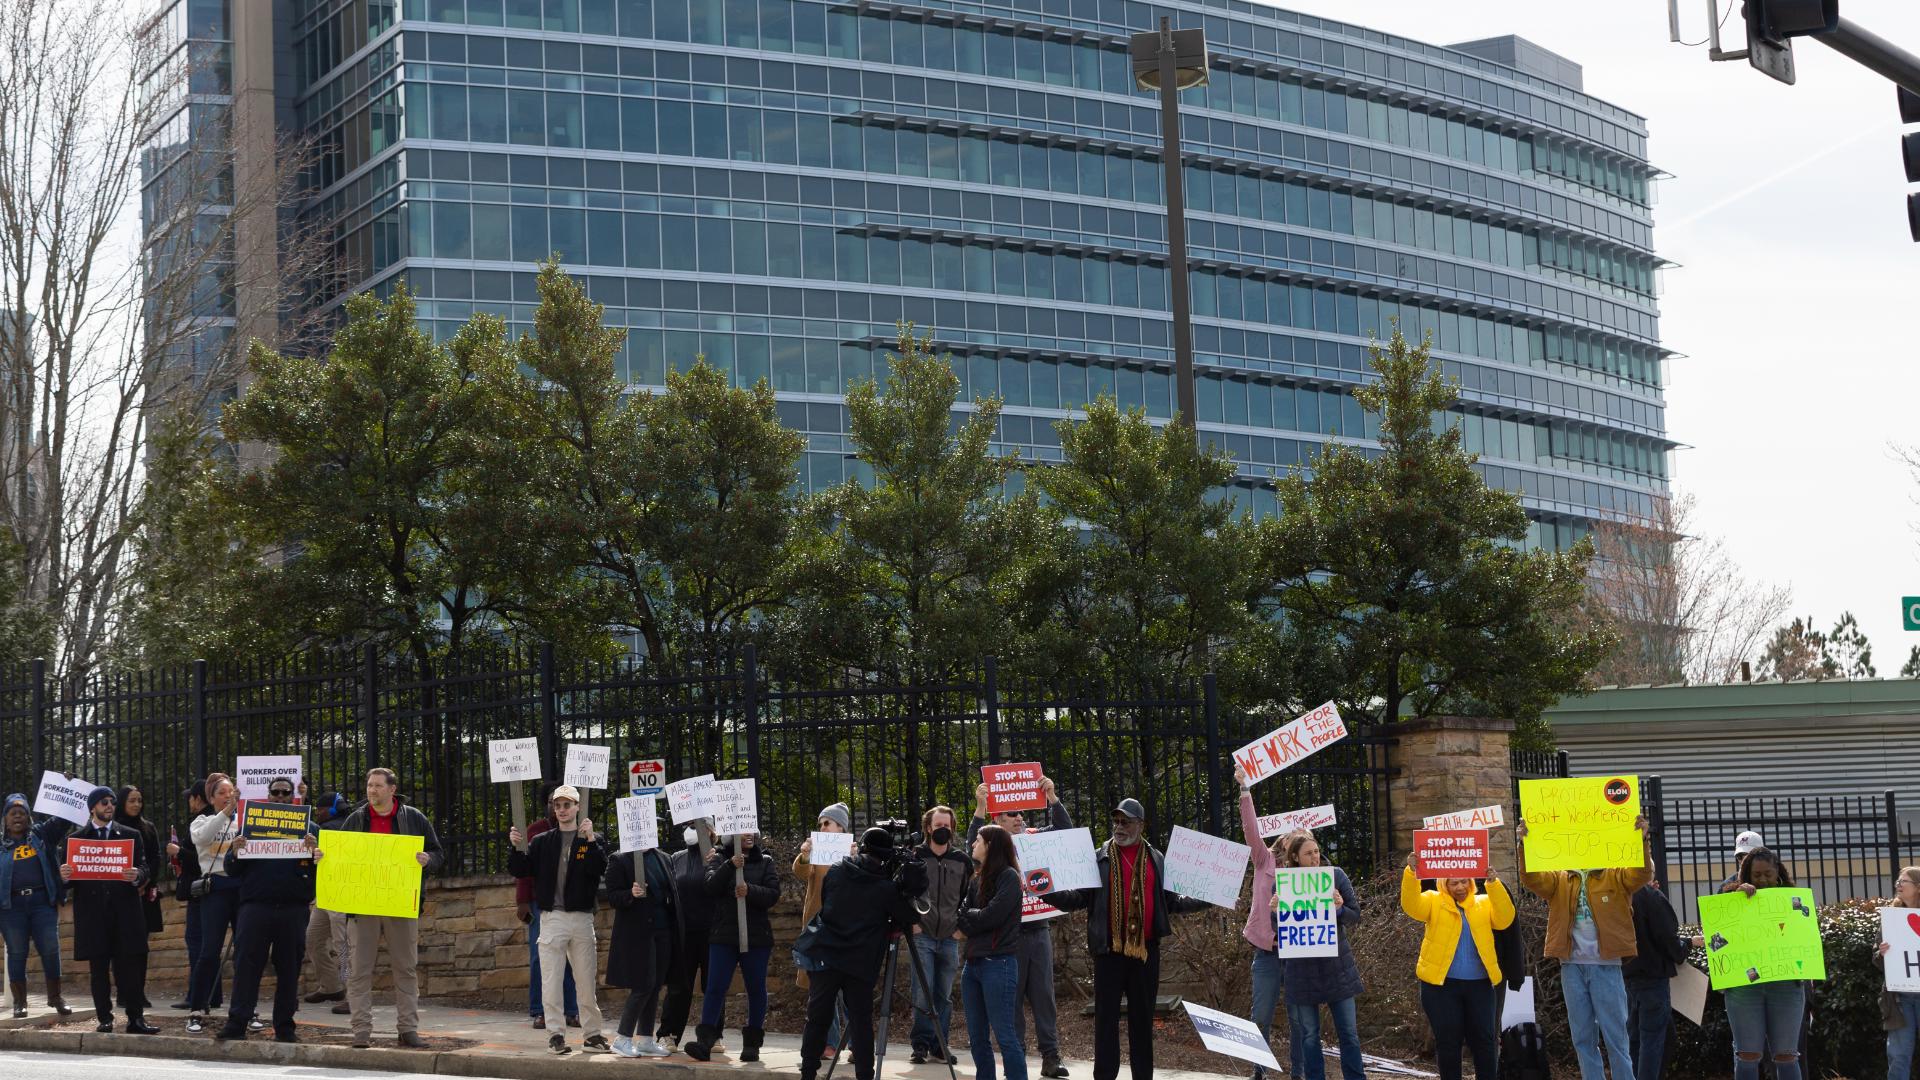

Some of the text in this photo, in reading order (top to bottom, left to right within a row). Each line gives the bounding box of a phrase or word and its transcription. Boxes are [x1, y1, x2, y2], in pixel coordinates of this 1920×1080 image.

[1307, 717, 1335, 735] THE
[1236, 705, 1334, 780] WE WORK FOR
[1310, 724, 1345, 749] PEOPLE
[512, 754, 522, 762] FOR
[638, 773, 657, 787] NO
[995, 770, 1034, 781] STOP THE
[44, 783, 89, 802] WORKERS OVE
[719, 781, 746, 791] THIS IS
[1607, 788, 1628, 796] ELON
[44, 791, 85, 811] BILLIONAIRES!
[717, 793, 744, 802] ILLEGAL
[994, 791, 1037, 803] TAKEOVER
[1541, 785, 1601, 806] PROTECT
[623, 797, 650, 810] PROTECT
[725, 804, 751, 813] AF and
[248, 808, 307, 821] OUR DEMOCRACY
[622, 810, 650, 821] PUBLIC
[1302, 812, 1320, 829] HEALTH
[1311, 814, 1334, 828] WORKER
[1425, 815, 1463, 830] HEALTH
[1470, 809, 1500, 828] ALL
[247, 817, 306, 830] IS UNDER ATTACK
[626, 820, 651, 832] HEALTH
[721, 825, 737, 833] VERY
[1258, 815, 1282, 836] JESUS
[240, 840, 312, 856] SOLIDARITY FOREVER
[1427, 837, 1475, 848] STOP THE
[1535, 832, 1601, 860] STOP
[80, 845, 122, 855] STOP THE
[1420, 849, 1482, 858] BILLIONAIRE
[73, 855, 128, 864] BILLIONAIRE
[1425, 860, 1478, 869] TAKEOVER
[77, 864, 123, 873] TAKEOVER
[1030, 877, 1049, 886] ELON
[1277, 871, 1332, 897] FUND
[1278, 896, 1334, 923] DON'T
[1278, 924, 1336, 950] FREEZE
[1195, 1016, 1259, 1042] THE CDC SAVES
[1222, 1031, 1244, 1044] LIVES
